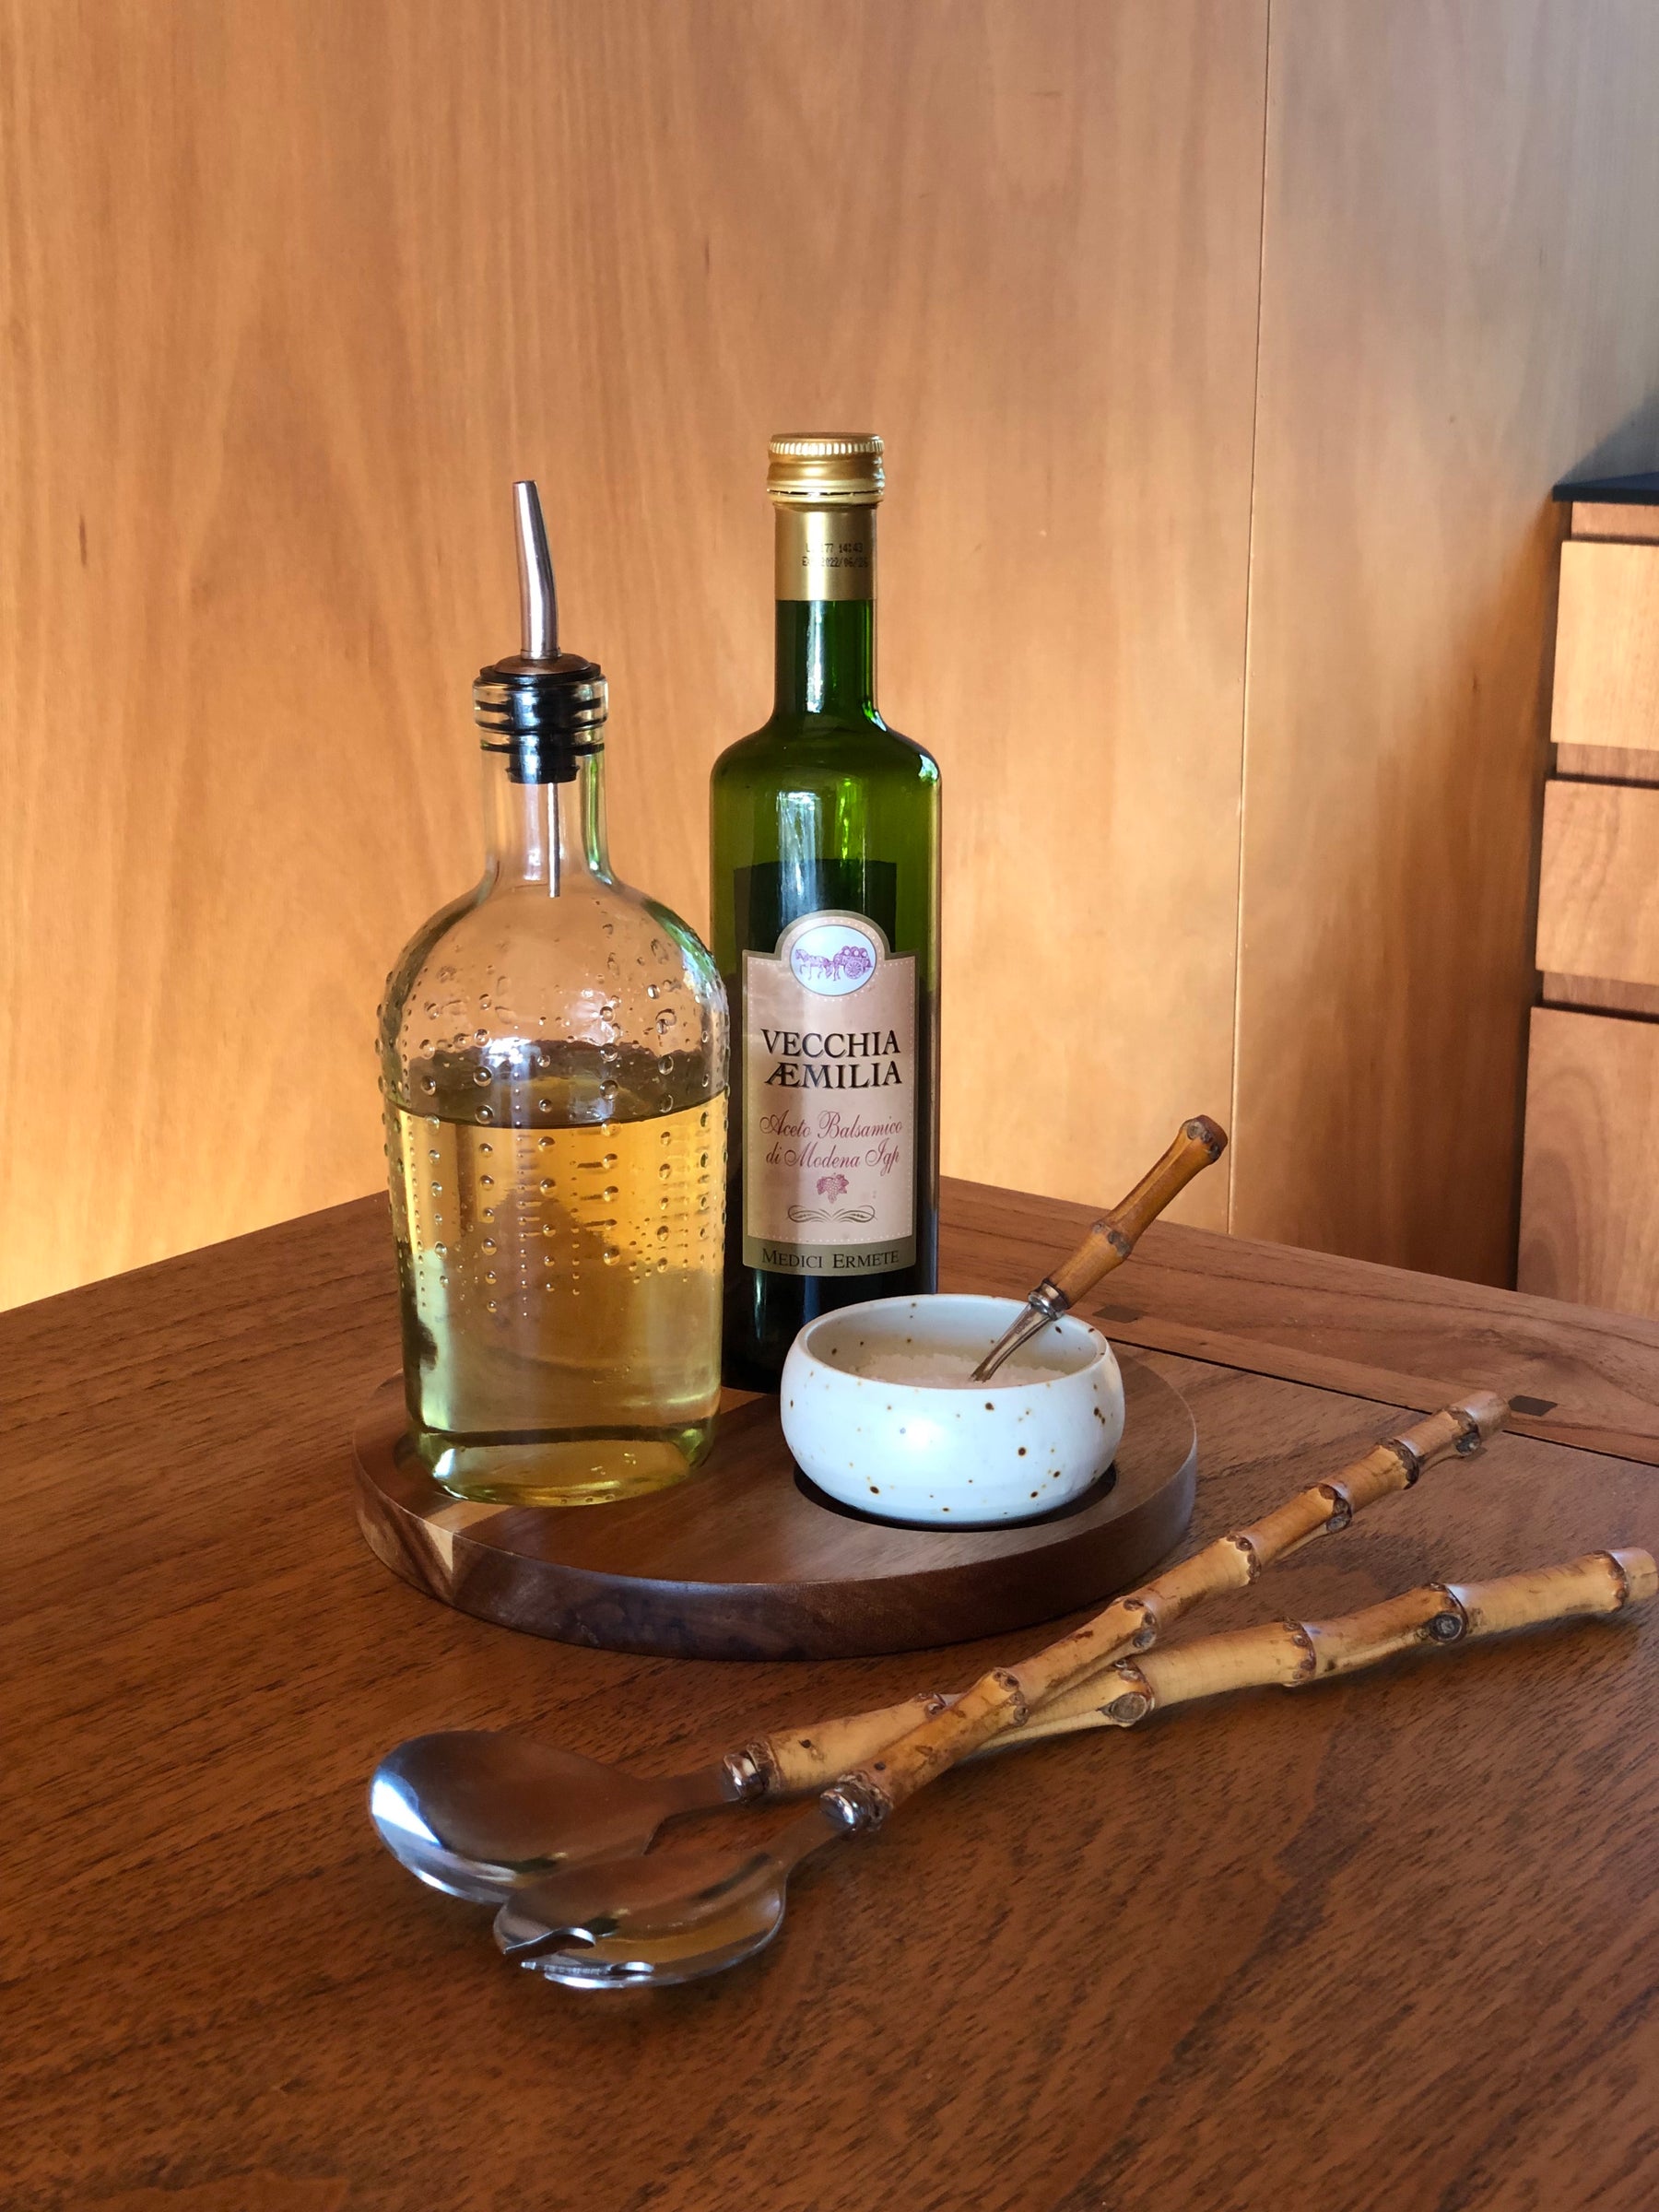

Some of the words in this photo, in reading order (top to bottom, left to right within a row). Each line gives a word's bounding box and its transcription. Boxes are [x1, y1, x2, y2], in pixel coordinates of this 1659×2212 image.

[760, 1029, 901, 1058] VECCHIA
[764, 1060, 902, 1089] ÆMILIA
[759, 1109, 811, 1137] Aceto
[817, 1110, 902, 1139] Balsamico
[766, 1141, 782, 1165] di
[783, 1141, 860, 1169] Modena
[865, 1137, 900, 1176] Igp
[761, 1248, 822, 1269] MEDICI
[832, 1250, 899, 1269] ERMETE
